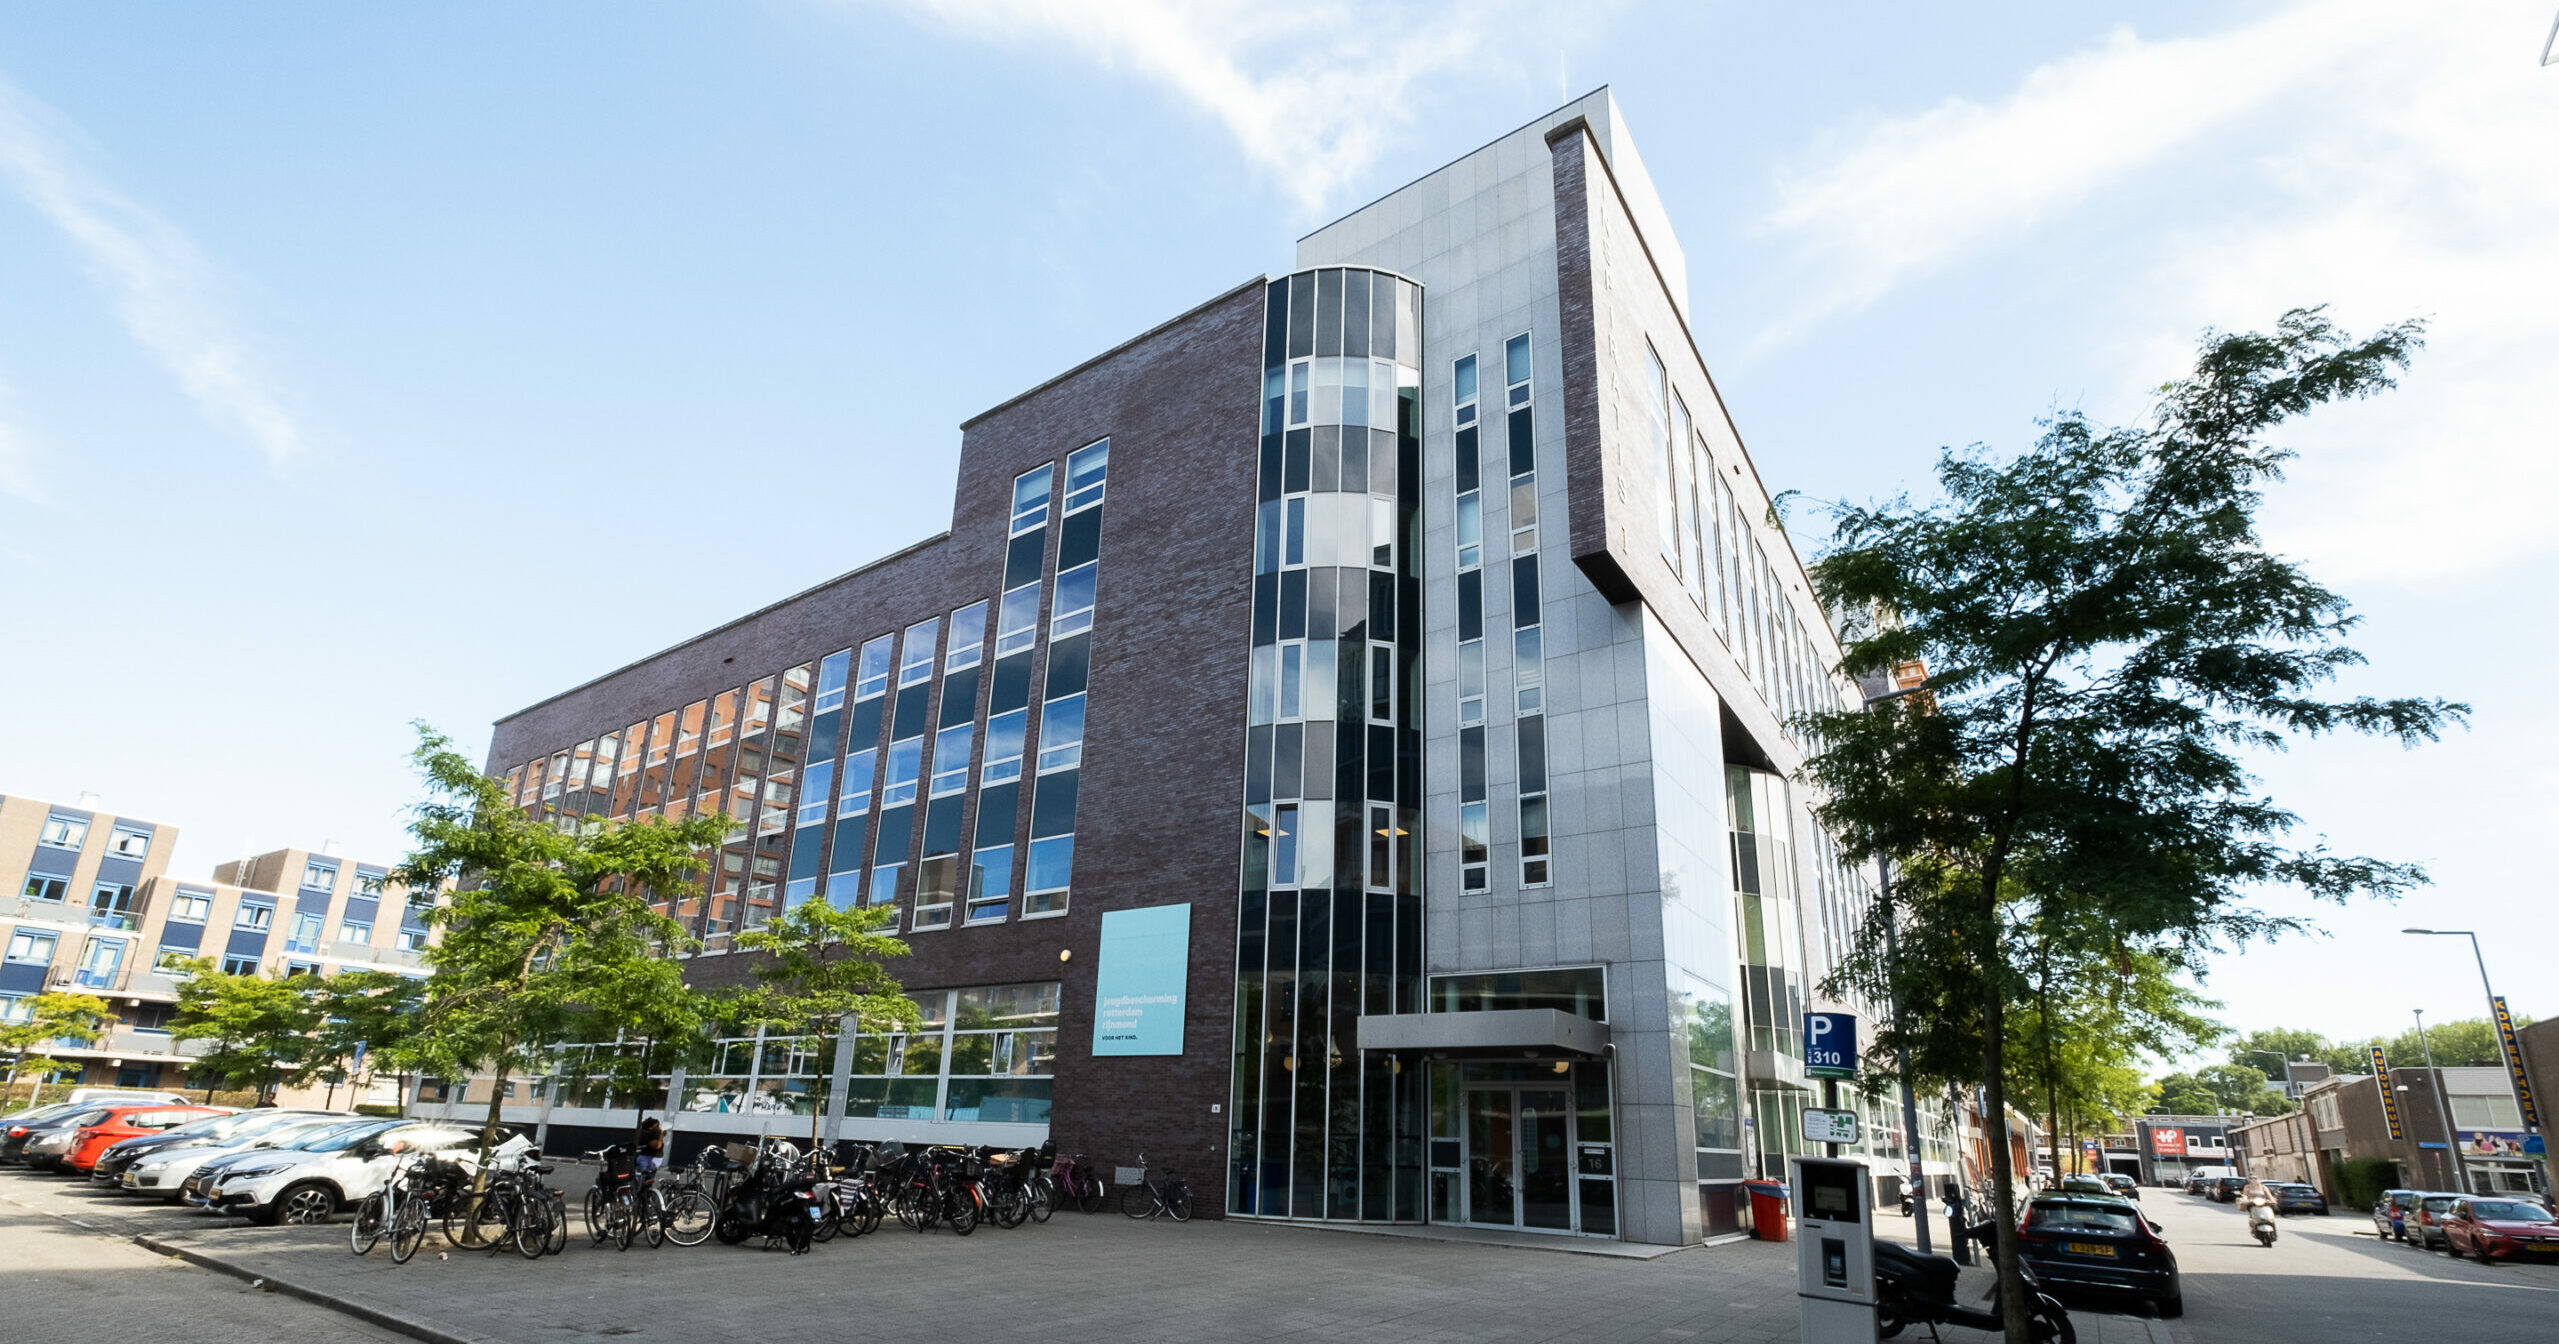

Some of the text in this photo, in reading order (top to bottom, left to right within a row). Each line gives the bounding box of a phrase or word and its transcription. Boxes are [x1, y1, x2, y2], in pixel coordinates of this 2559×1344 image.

[1103, 1007, 1143, 1017] rotterdam
[1102, 1018, 1138, 1032] rijnmond
[1811, 1015, 1832, 1046] P
[1813, 1051, 1841, 1065] 310
[2374, 1050, 2401, 1137] AUTOVERHUUR
